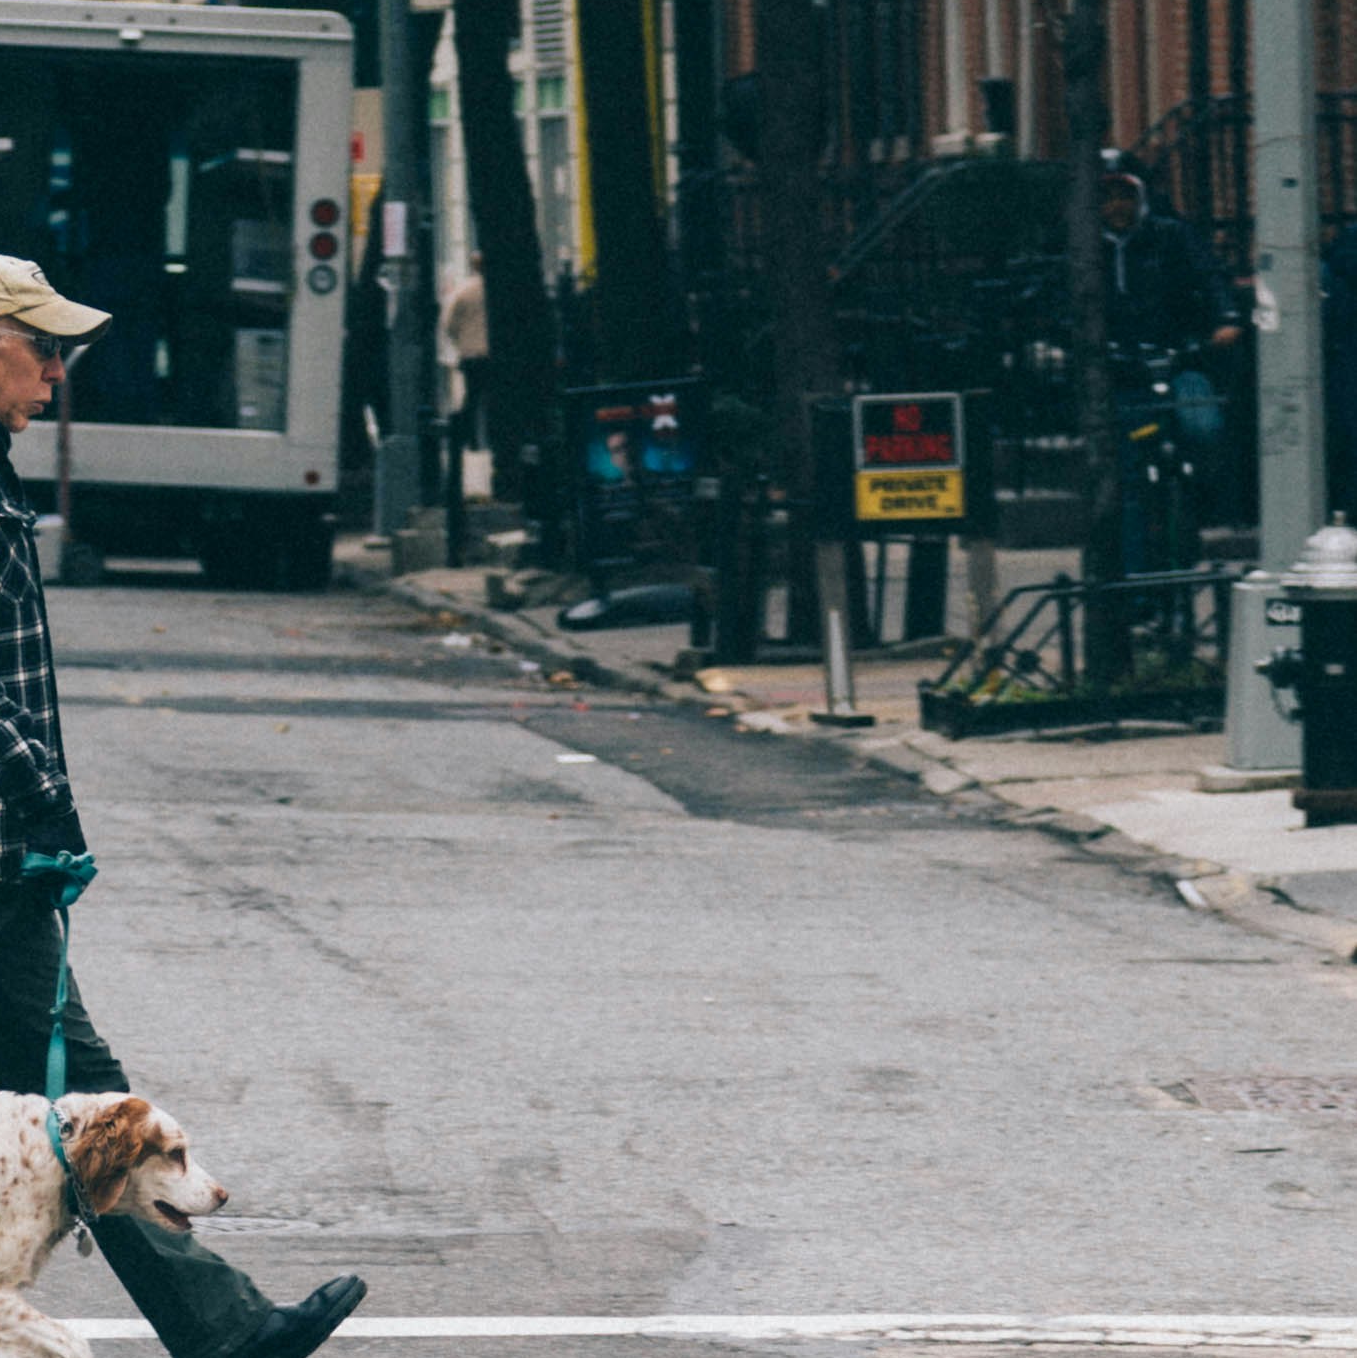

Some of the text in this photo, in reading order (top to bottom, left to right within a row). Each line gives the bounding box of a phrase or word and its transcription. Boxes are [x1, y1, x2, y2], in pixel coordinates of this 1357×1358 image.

[893, 404, 921, 431] NO
[865, 434, 952, 462] PARKING
[869, 475, 947, 493] PRIVATE
[879, 495, 938, 511] DRIVE
